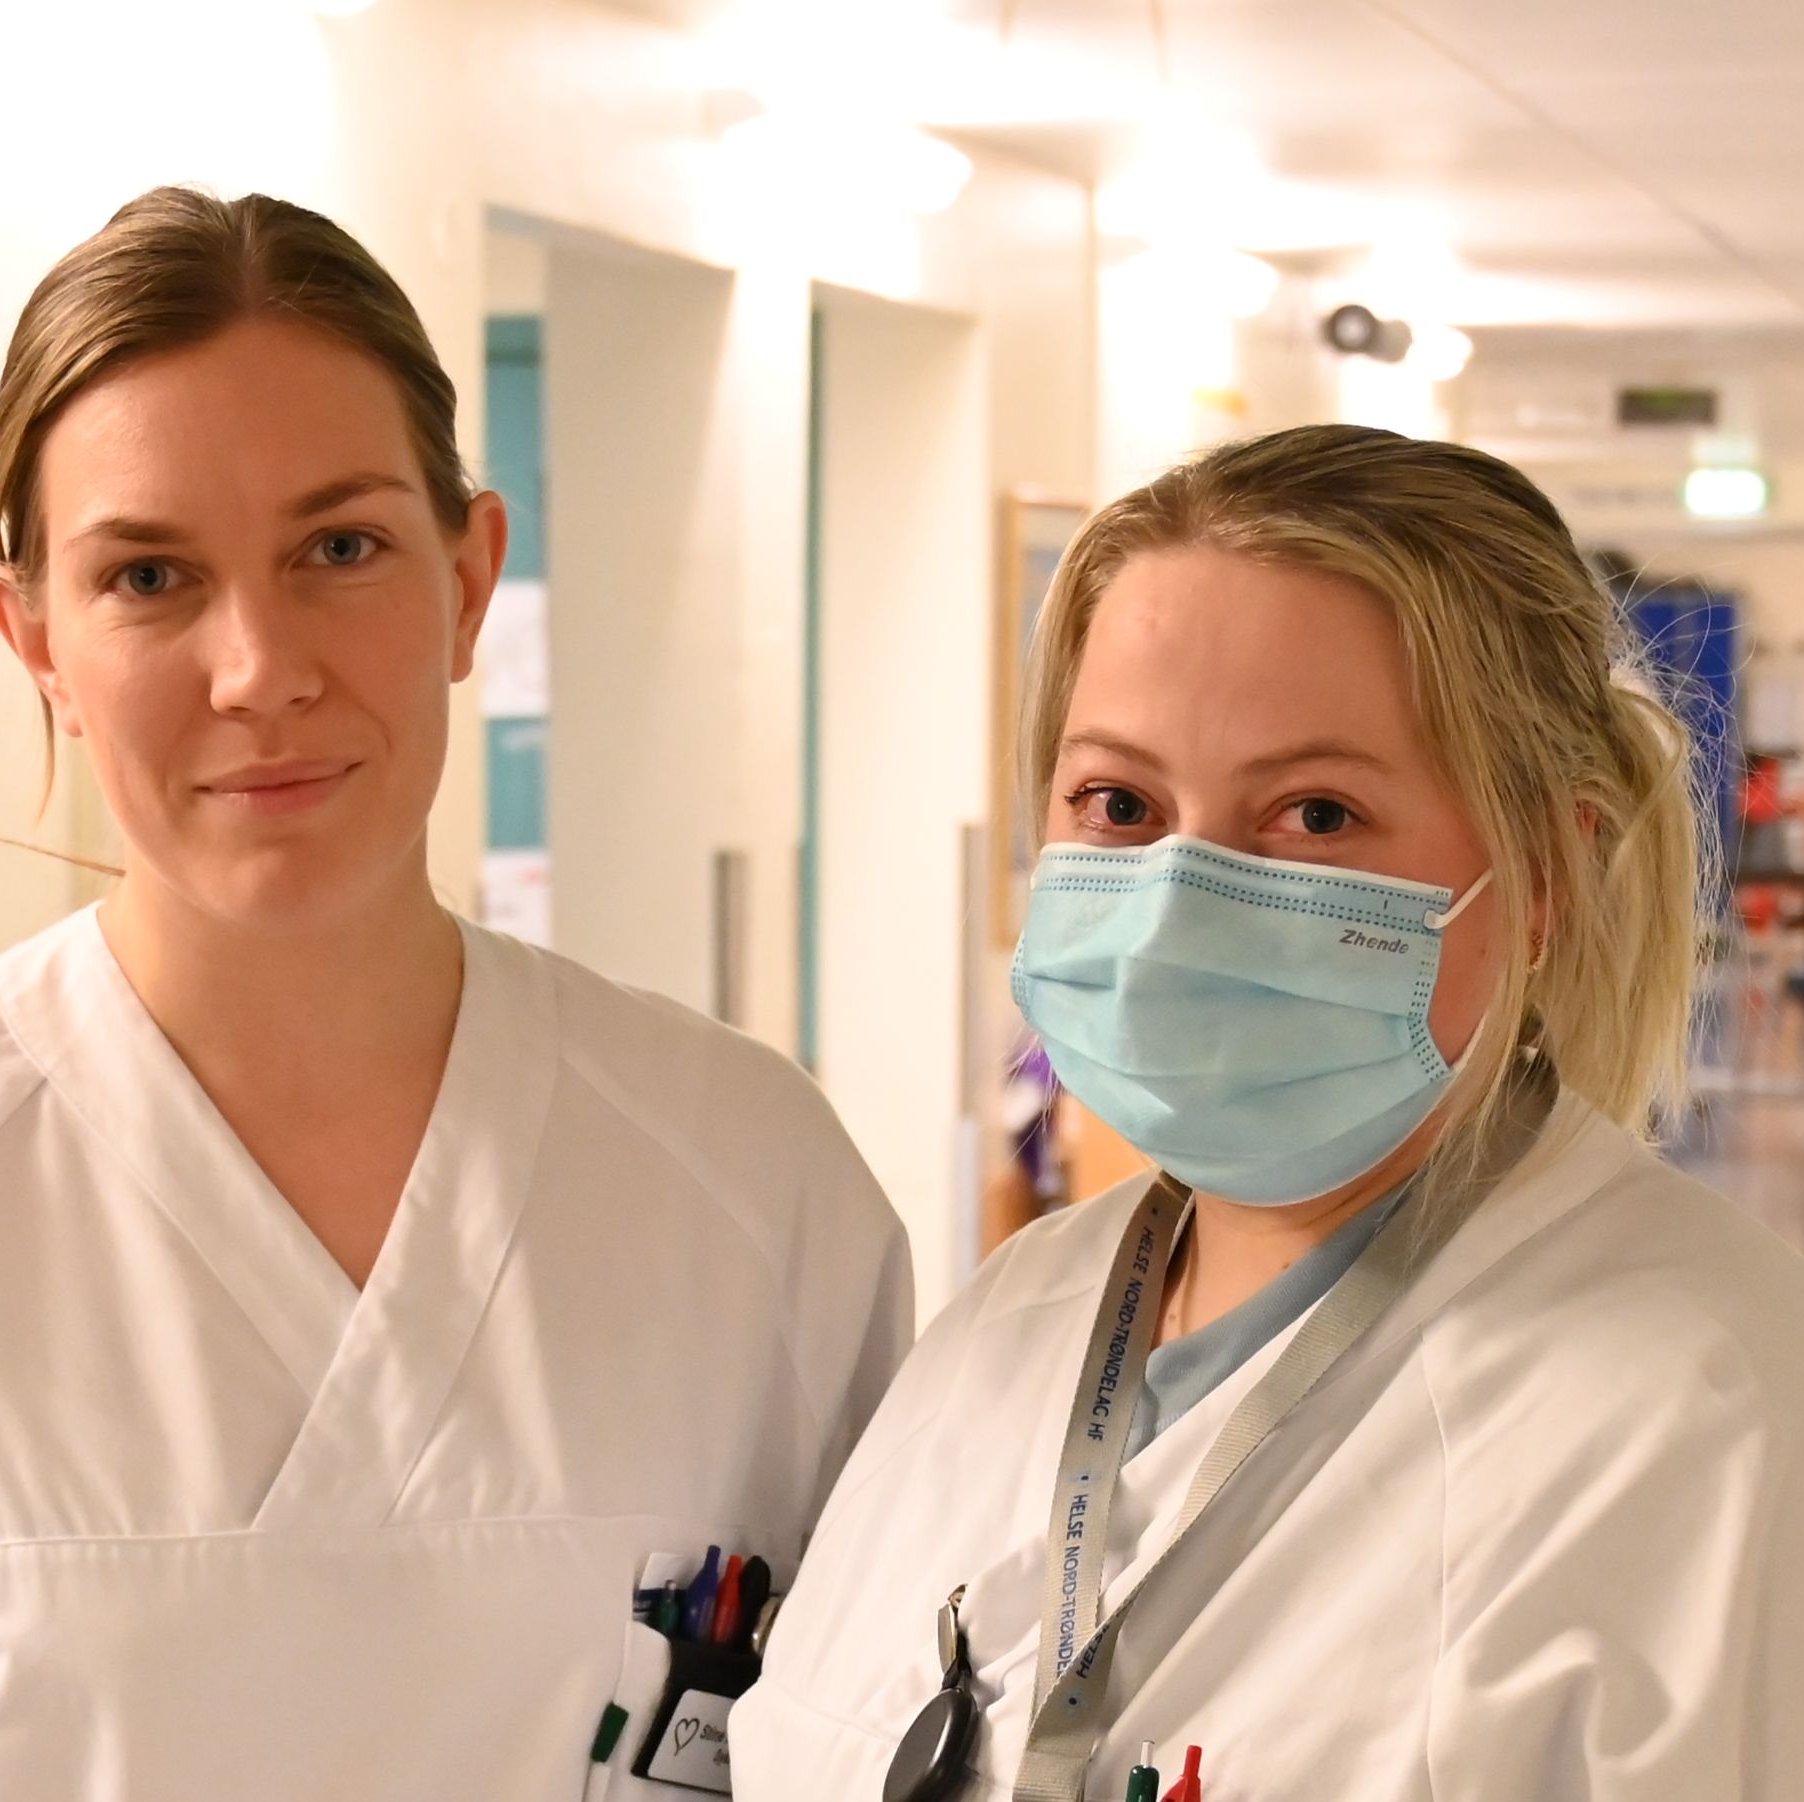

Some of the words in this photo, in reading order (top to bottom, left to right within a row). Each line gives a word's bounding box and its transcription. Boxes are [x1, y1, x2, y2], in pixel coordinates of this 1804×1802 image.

[1339, 929, 1410, 954] Zhende
[1132, 1225, 1155, 1275] HELSE
[1092, 1277, 1145, 1418] NORD-TRØNDELAG
[1087, 1421, 1106, 1441] HF
[1066, 1493, 1089, 1541] HELSE
[1056, 1545, 1081, 1677] NORD-TRØNDE
